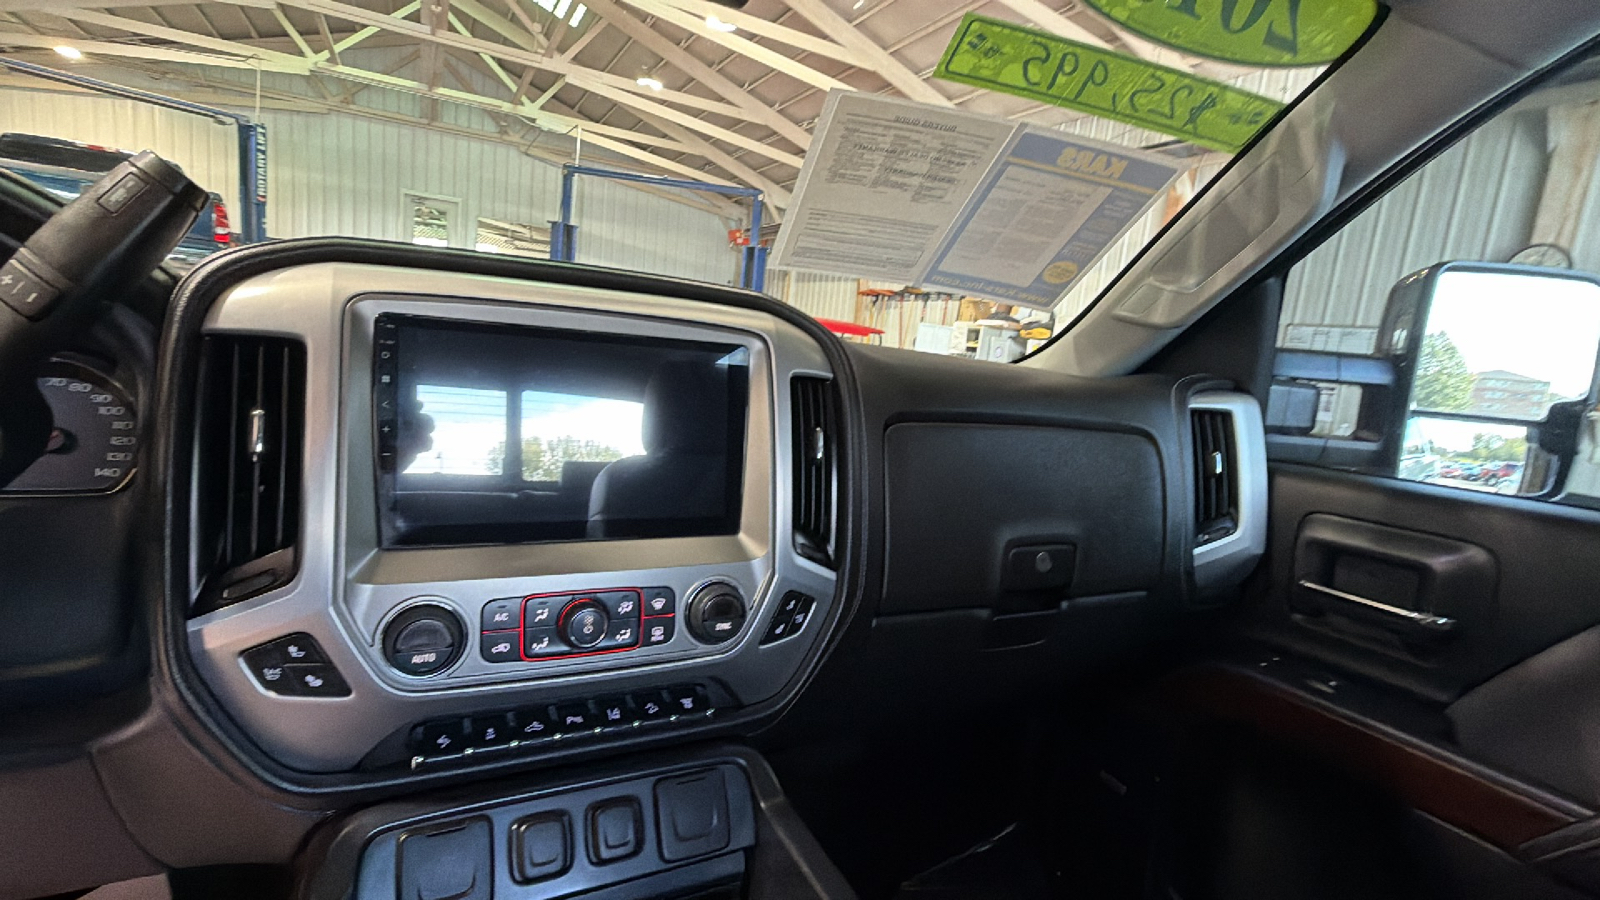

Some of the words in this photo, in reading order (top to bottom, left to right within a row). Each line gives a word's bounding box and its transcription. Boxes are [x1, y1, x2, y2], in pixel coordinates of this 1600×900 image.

[256, 126, 266, 150] LIFT
[46, 378, 67, 387] 70
[68, 382, 93, 393] 80
[98, 406, 125, 415] 100
[110, 436, 136, 445] 120
[106, 452, 132, 461] 130
[94, 467, 120, 477] 140
[411, 652, 437, 664] AUTO
